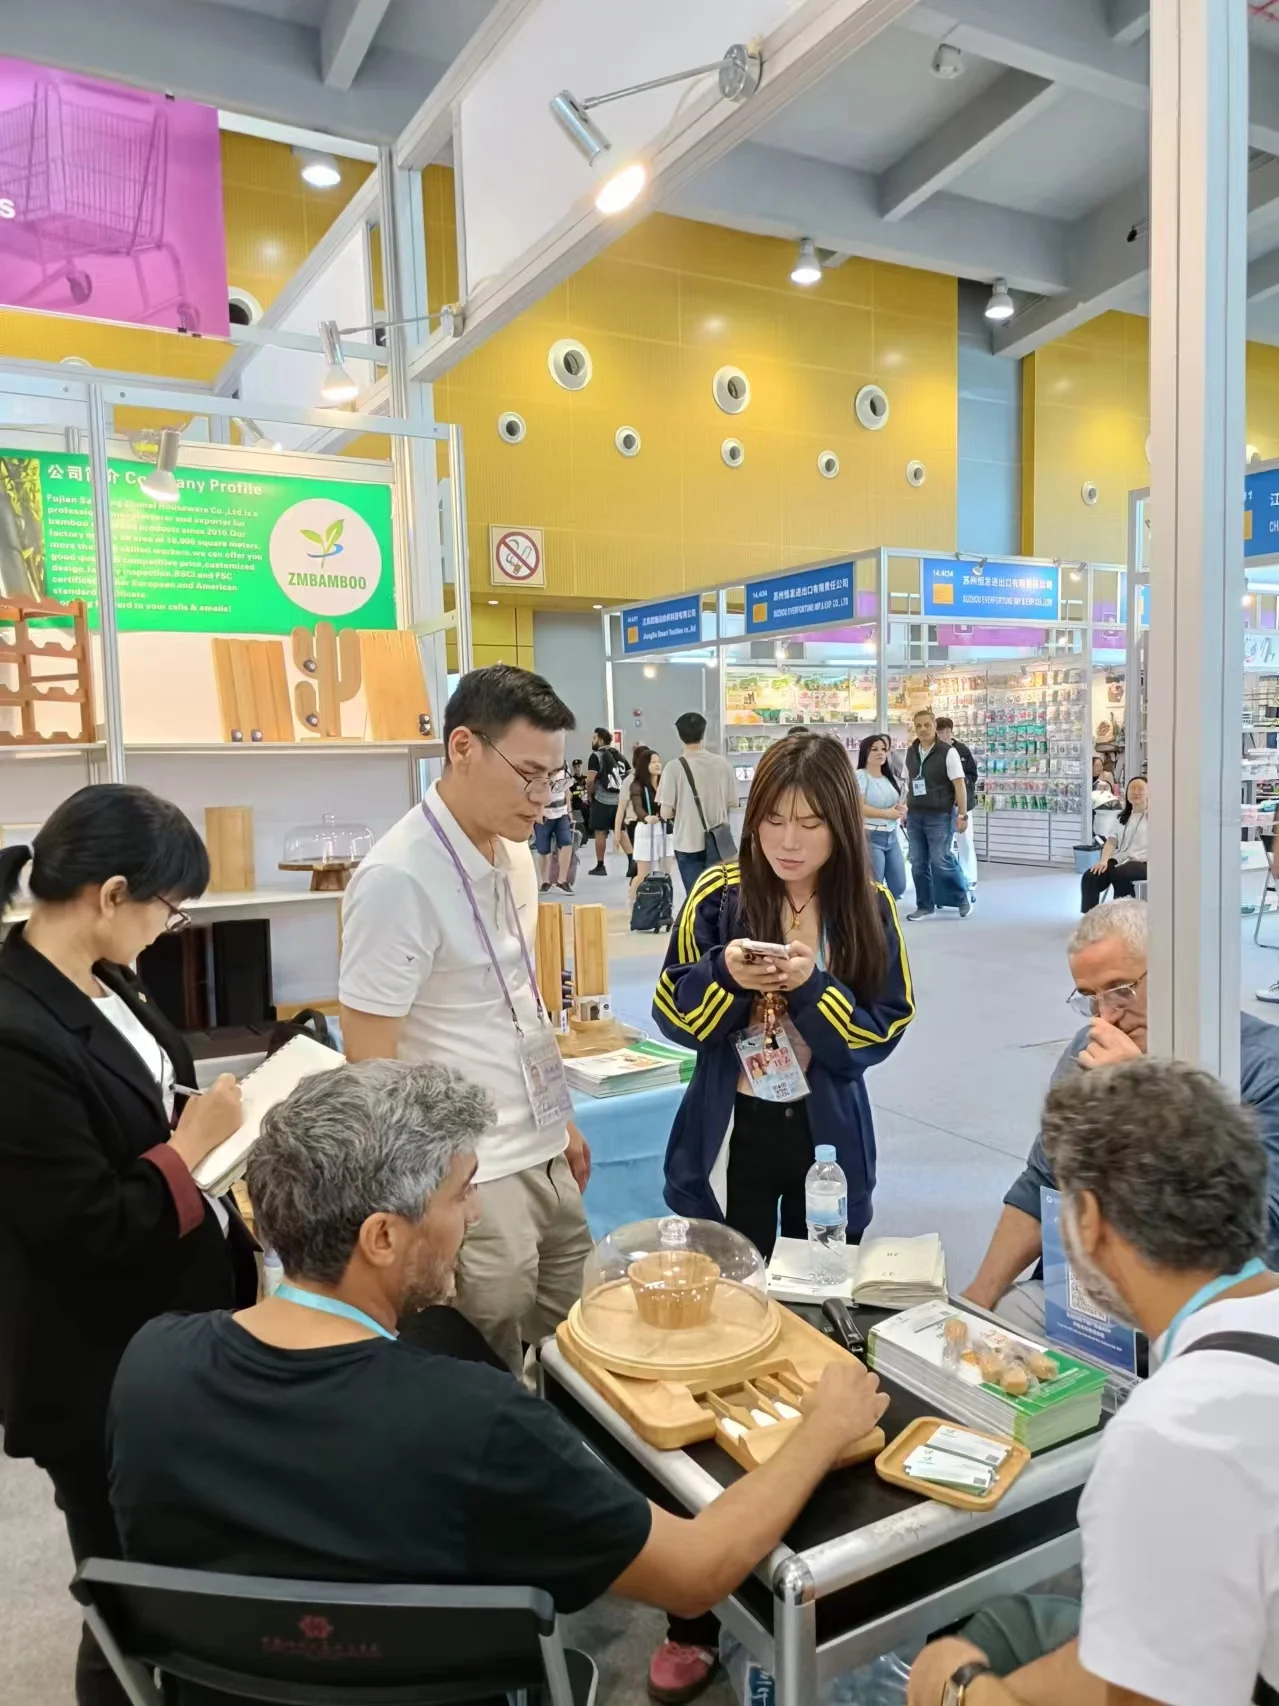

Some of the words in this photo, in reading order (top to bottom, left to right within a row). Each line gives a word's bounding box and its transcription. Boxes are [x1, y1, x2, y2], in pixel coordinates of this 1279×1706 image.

[125, 471, 205, 494] Coany
[210, 479, 263, 495] Profile
[47, 493, 76, 504] Fujian
[158, 503, 208, 513] Houseware
[48, 517, 89, 527] bamboo
[194, 517, 231, 527] exporter
[232, 519, 245, 527] for
[49, 528, 84, 540] factory
[197, 539, 227, 549] square
[51, 553, 76, 563] good
[225, 551, 246, 560] offer
[215, 572, 233, 581] FSC
[288, 572, 366, 590] ZMBAMBOO
[132, 580, 176, 590] European
[196, 583, 238, 592] American
[53, 587, 98, 597] standard
[146, 603, 166, 611] your
[190, 604, 198, 612] &
